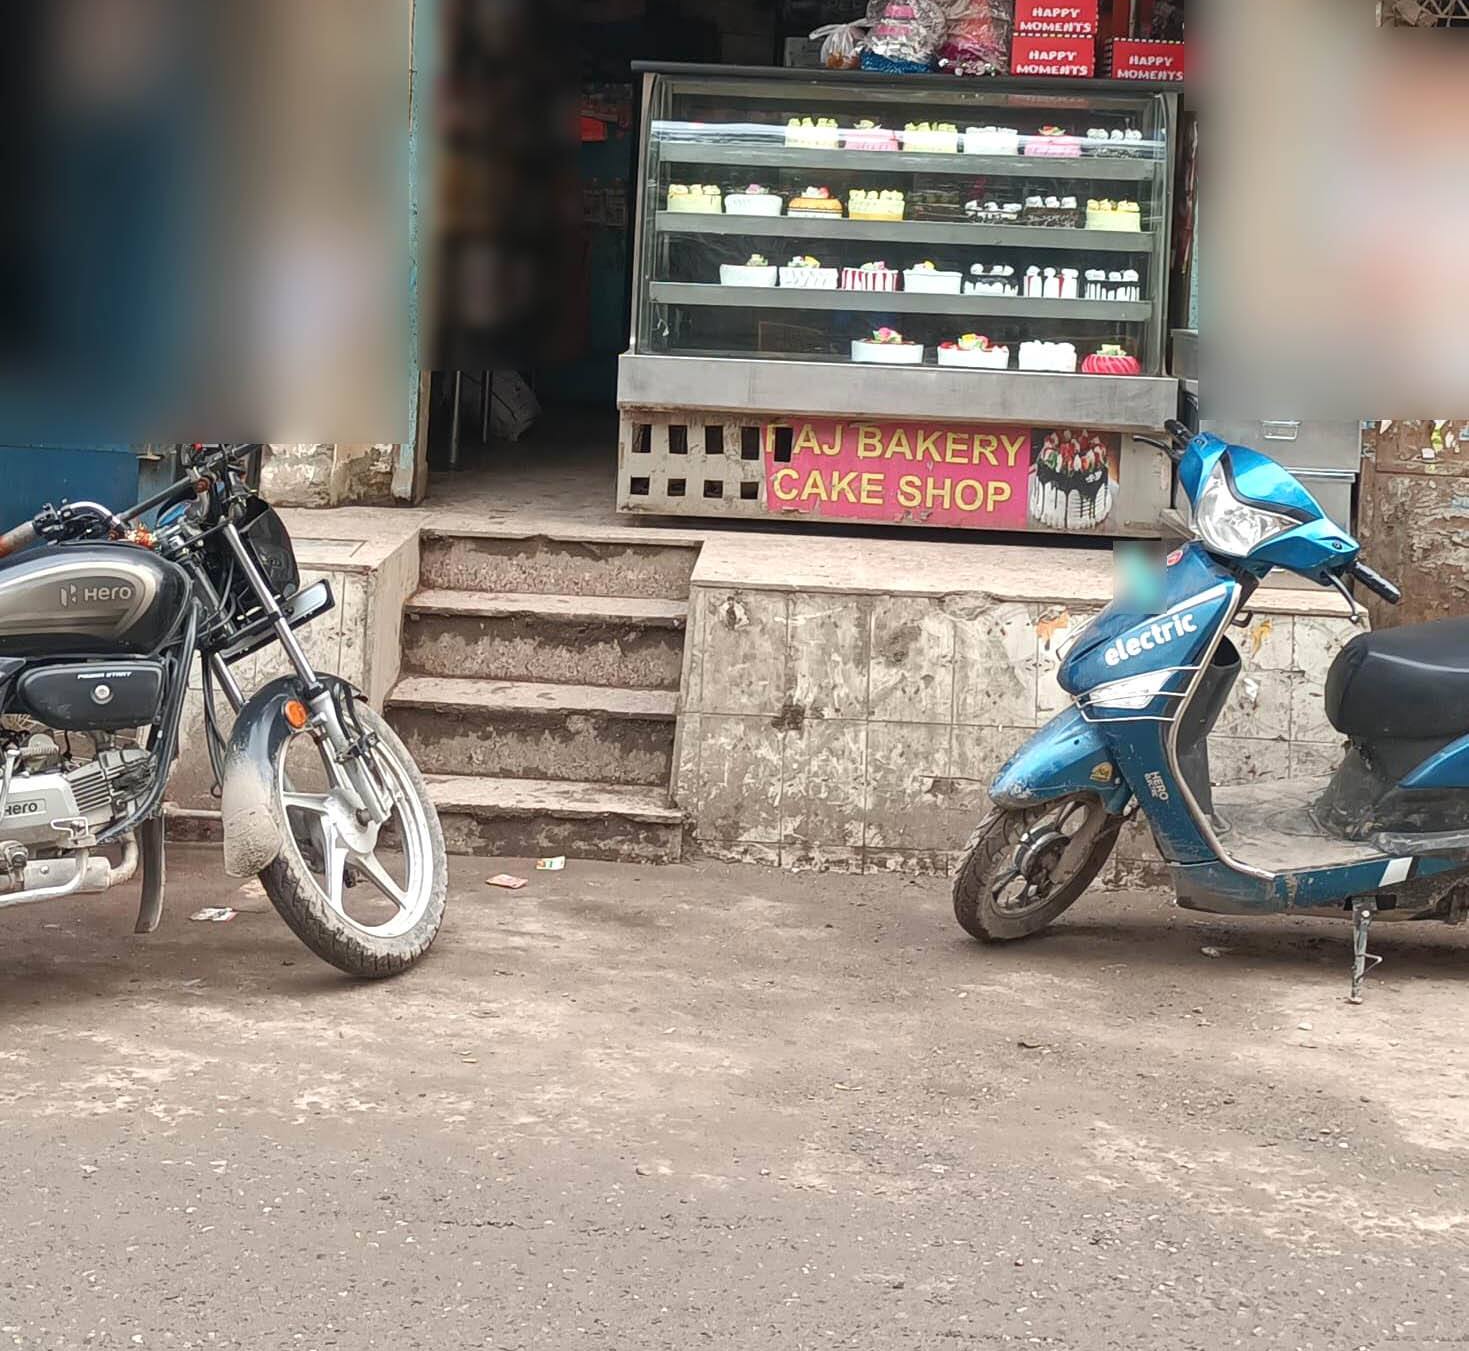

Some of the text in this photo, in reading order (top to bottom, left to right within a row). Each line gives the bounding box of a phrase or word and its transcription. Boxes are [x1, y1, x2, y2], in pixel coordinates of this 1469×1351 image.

[1031, 7, 1080, 18] HAPPY
[1019, 21, 1092, 33] MOMENTS
[1028, 50, 1077, 61] HAPPY
[1128, 55, 1174, 67] HAPPY
[1016, 64, 1088, 76] MOMENTS
[1117, 68, 1184, 81] MOMENTS
[857, 426, 1026, 467] BAKERY
[773, 468, 1012, 513] CAKE SHOP
[84, 586, 132, 601] Hero
[1104, 613, 1198, 666] electric
[1148, 770, 1169, 801] HERO
